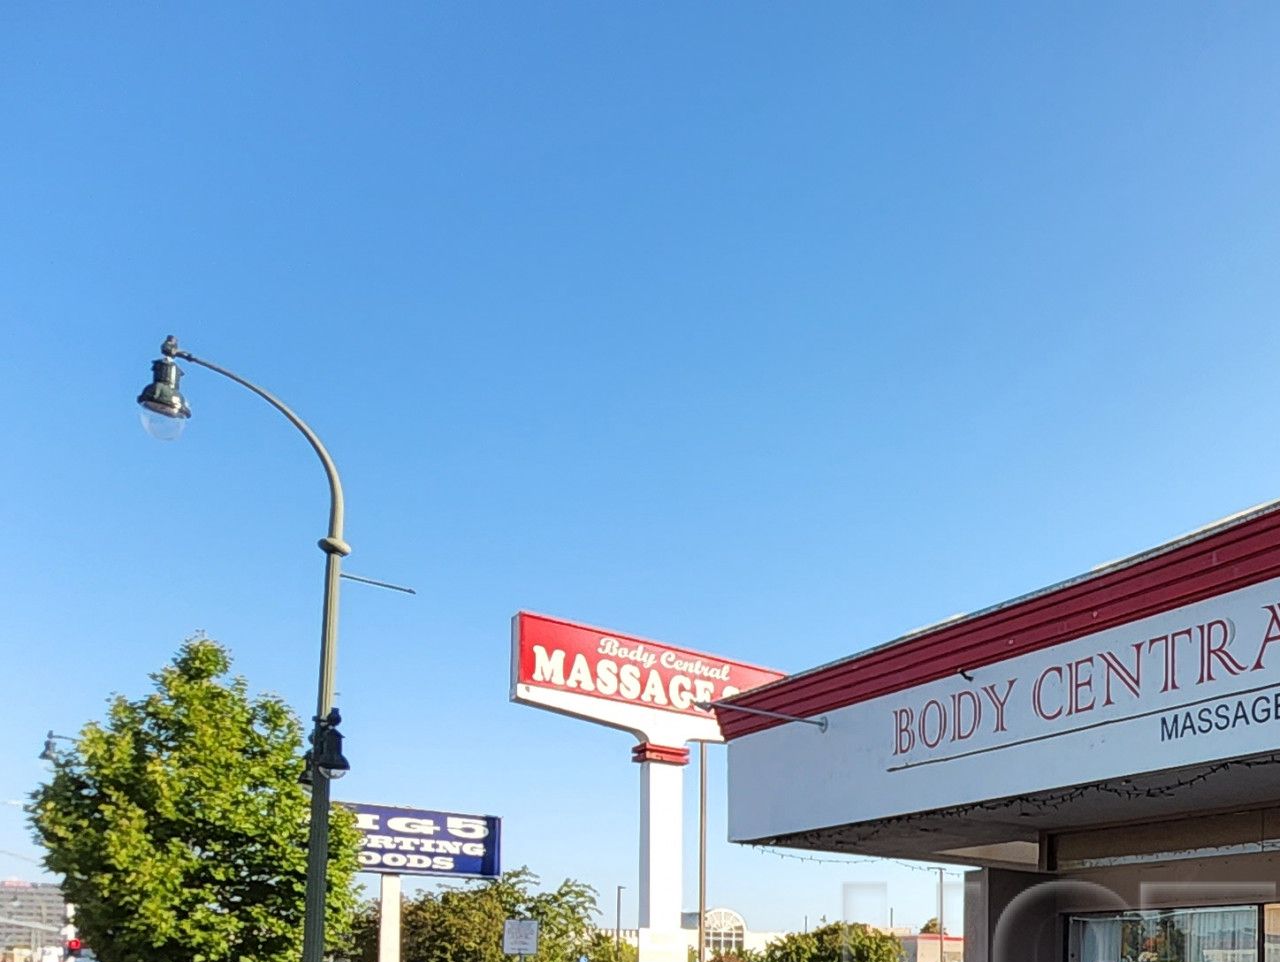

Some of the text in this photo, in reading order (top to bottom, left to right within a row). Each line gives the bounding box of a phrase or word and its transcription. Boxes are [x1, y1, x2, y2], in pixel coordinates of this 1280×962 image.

[532, 645, 715, 716] MASSAGE
[597, 637, 730, 681] Body Central
[892, 678, 1017, 756] BODY
[354, 813, 490, 840] IG 5
[357, 851, 455, 871] OODS
